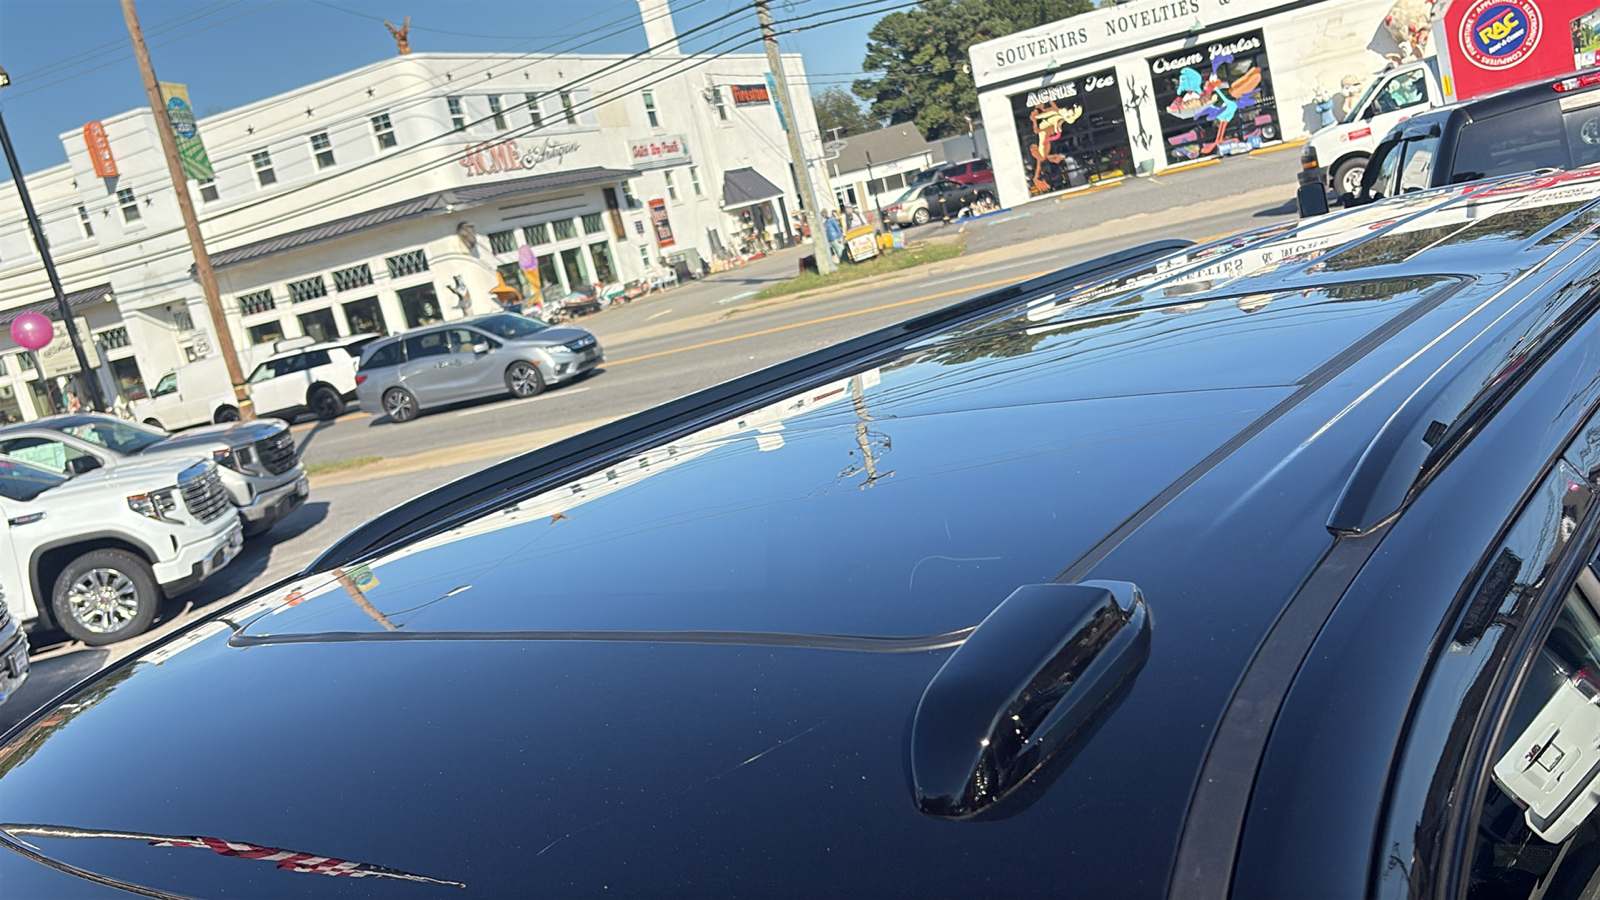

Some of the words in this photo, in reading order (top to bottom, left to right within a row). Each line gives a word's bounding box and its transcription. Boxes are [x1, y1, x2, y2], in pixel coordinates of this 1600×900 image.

[996, 27, 1088, 67] SOUVENIRS
[1105, 0, 1200, 37] NOVELTIES
[1464, 18, 1477, 56] FURNITURE
[1478, 11, 1520, 45] RAC
[1522, 3, 1538, 46] ELECTRONICS
[1152, 52, 1204, 74] Cream
[1208, 37, 1262, 61] Parlor
[1481, 51, 1522, 65] COMPUTERS
[1026, 81, 1078, 108] ACME
[1084, 75, 1115, 92] Ice
[459, 140, 524, 176] ACME
[536, 137, 581, 165] Antiques
